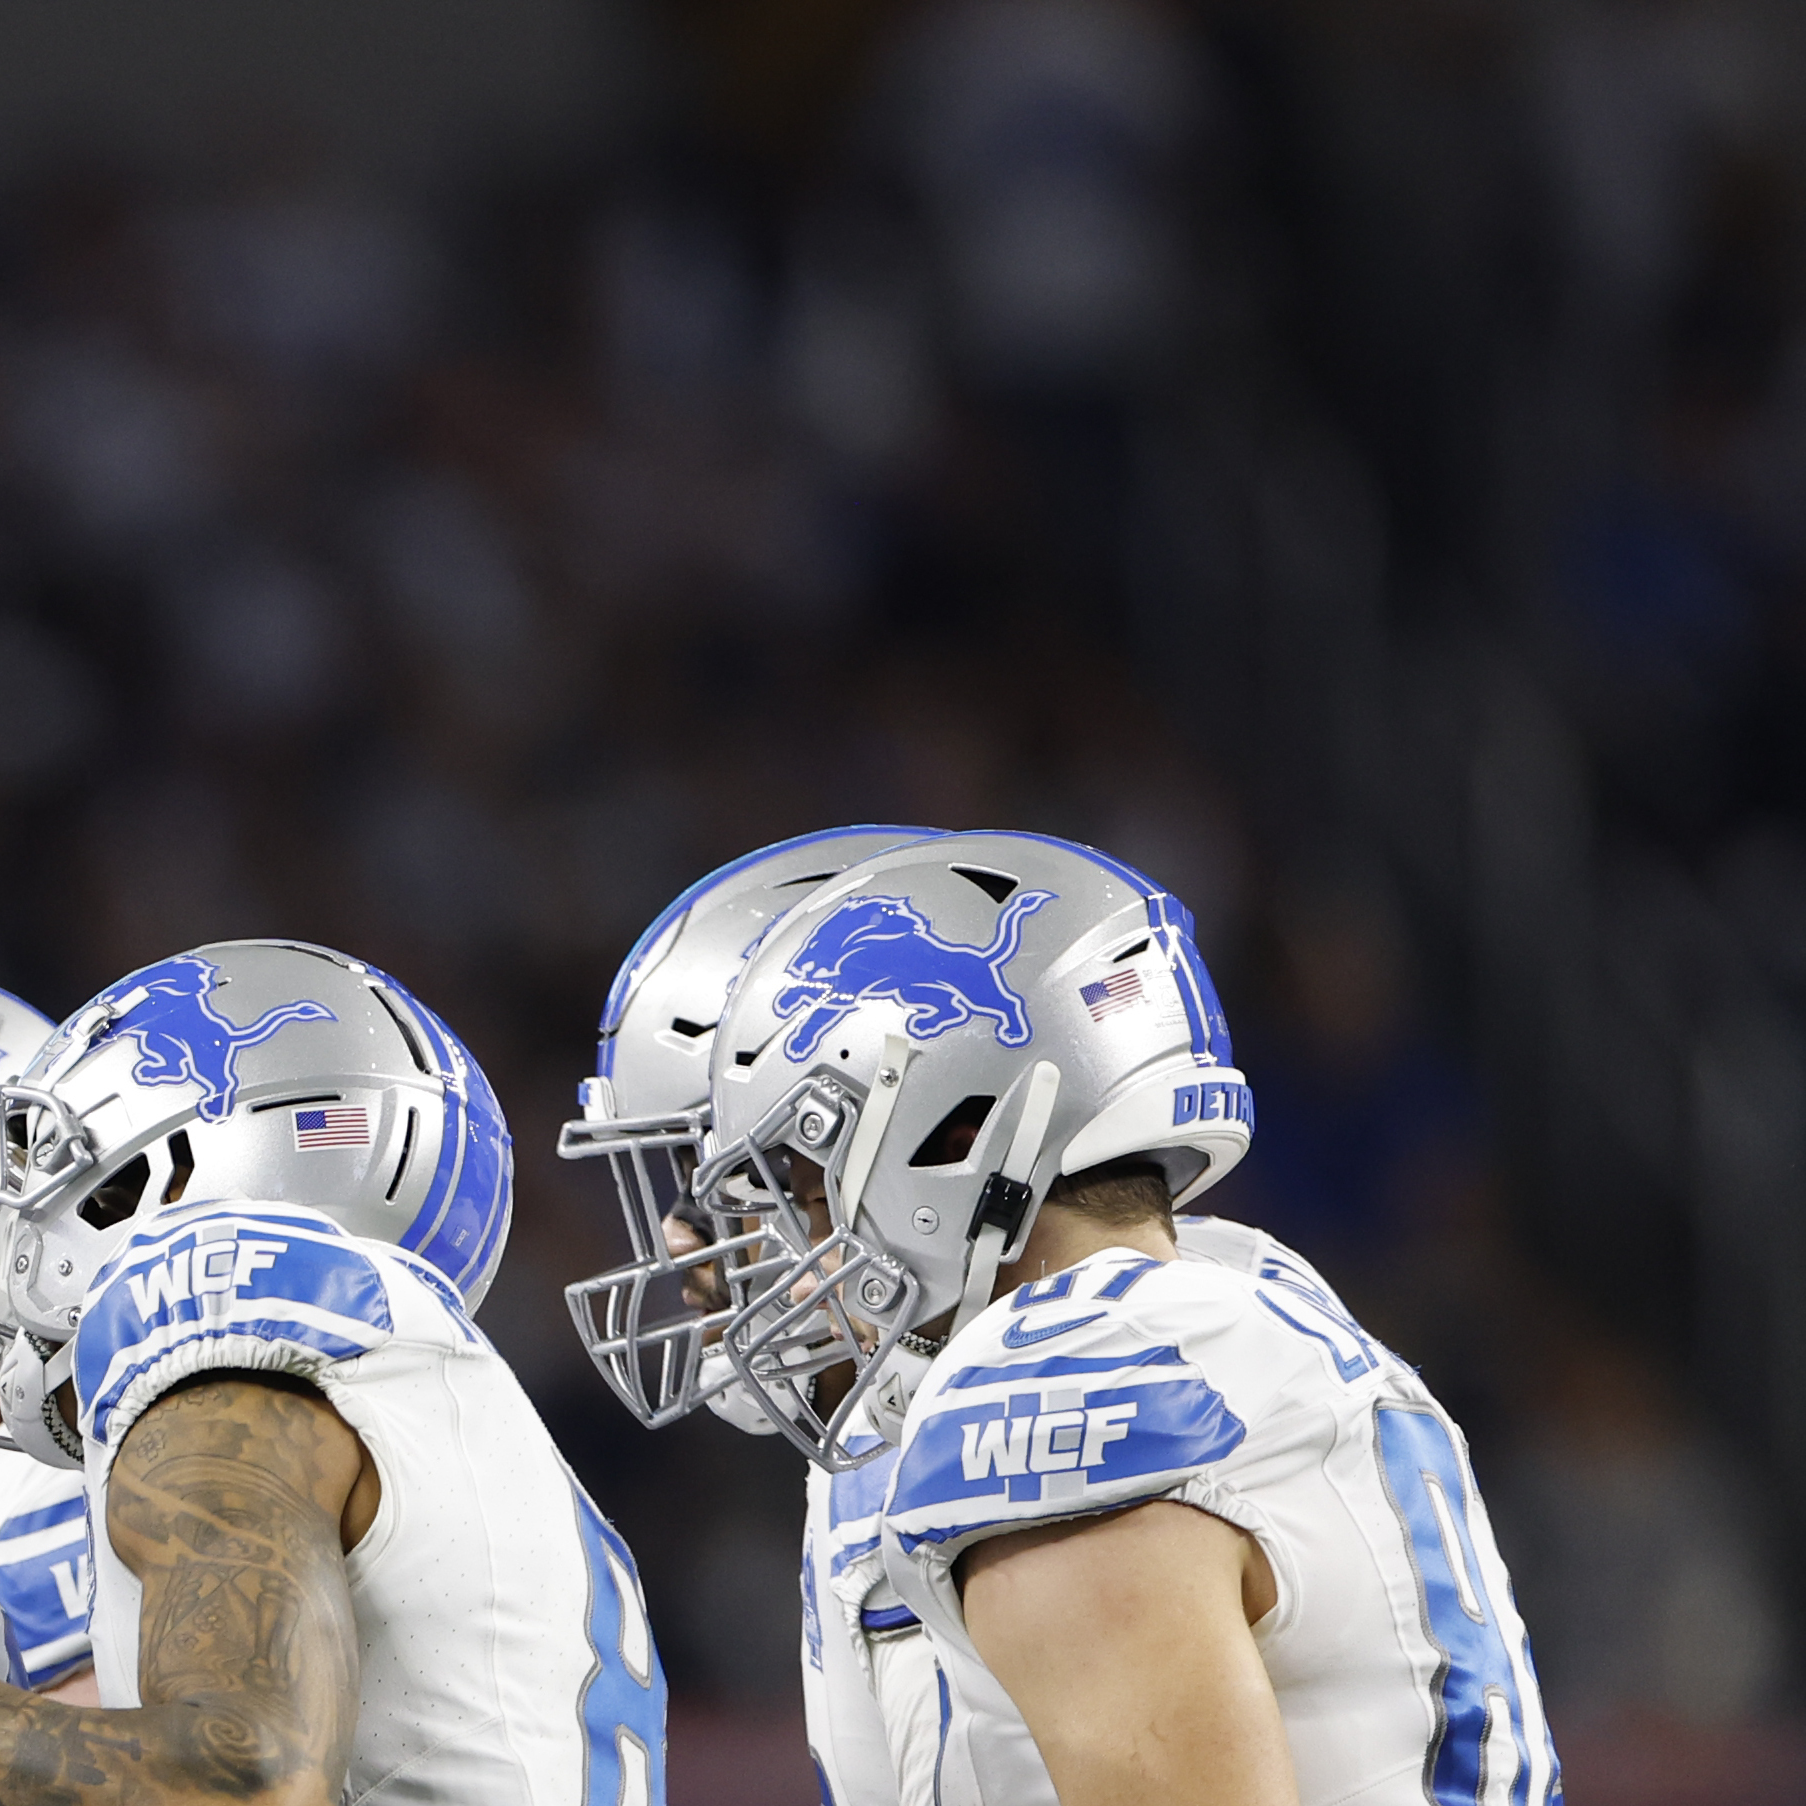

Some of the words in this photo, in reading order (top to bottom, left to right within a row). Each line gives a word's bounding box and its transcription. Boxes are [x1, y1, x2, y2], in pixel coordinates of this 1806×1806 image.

[1172, 1081, 1256, 1139] DETR
[125, 1238, 289, 1325] WCF
[959, 1401, 1138, 1480] WCF
